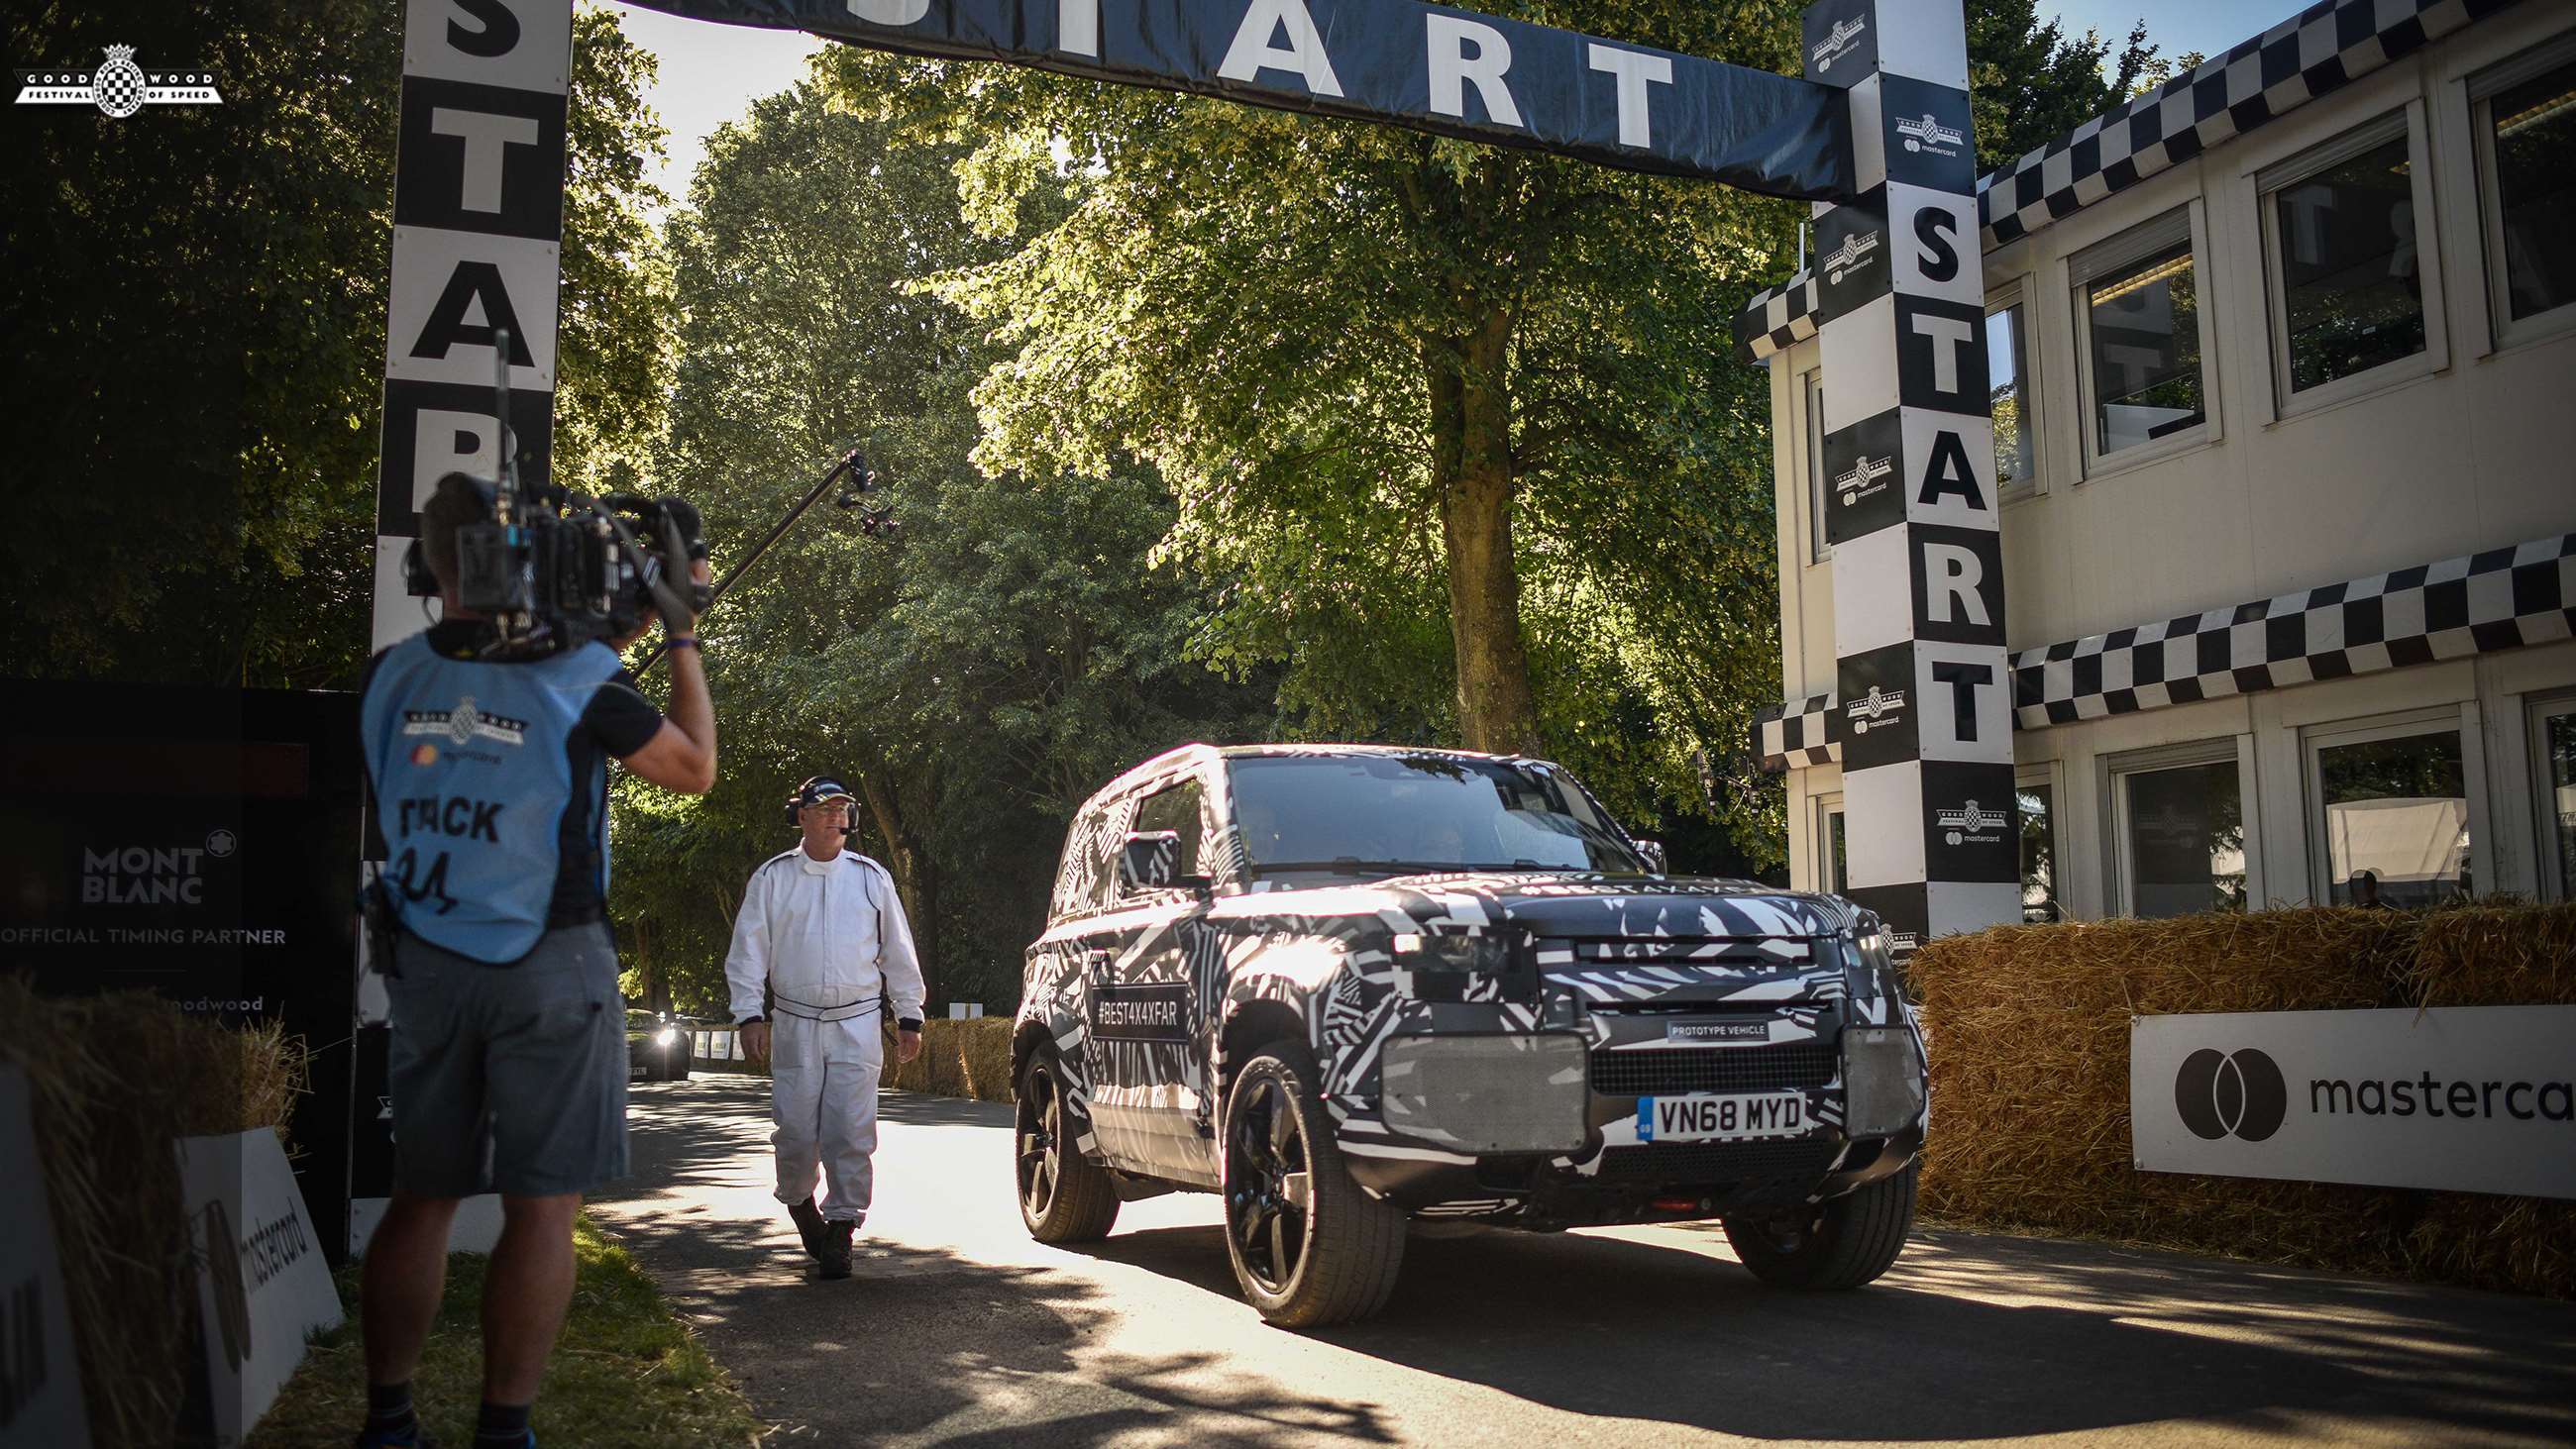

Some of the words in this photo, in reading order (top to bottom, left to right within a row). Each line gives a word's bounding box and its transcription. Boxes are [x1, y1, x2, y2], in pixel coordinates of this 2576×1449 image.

[846, 0, 1672, 149] ART
[83, 846, 204, 876] MONT
[82, 875, 204, 903] BLANC
[0, 928, 100, 944] OFFICIAL
[107, 928, 185, 944] TIMING
[192, 928, 285, 945] PARTNER
[172, 994, 264, 1011] oodwood
[1098, 1000, 1177, 1025] #BEST4X4XFAR
[1671, 1026, 1726, 1036] PROTOTYPE
[1728, 1024, 1766, 1035] VEHICLE
[1660, 1099, 1738, 1134] VN68
[1746, 1097, 1801, 1130] MYD
